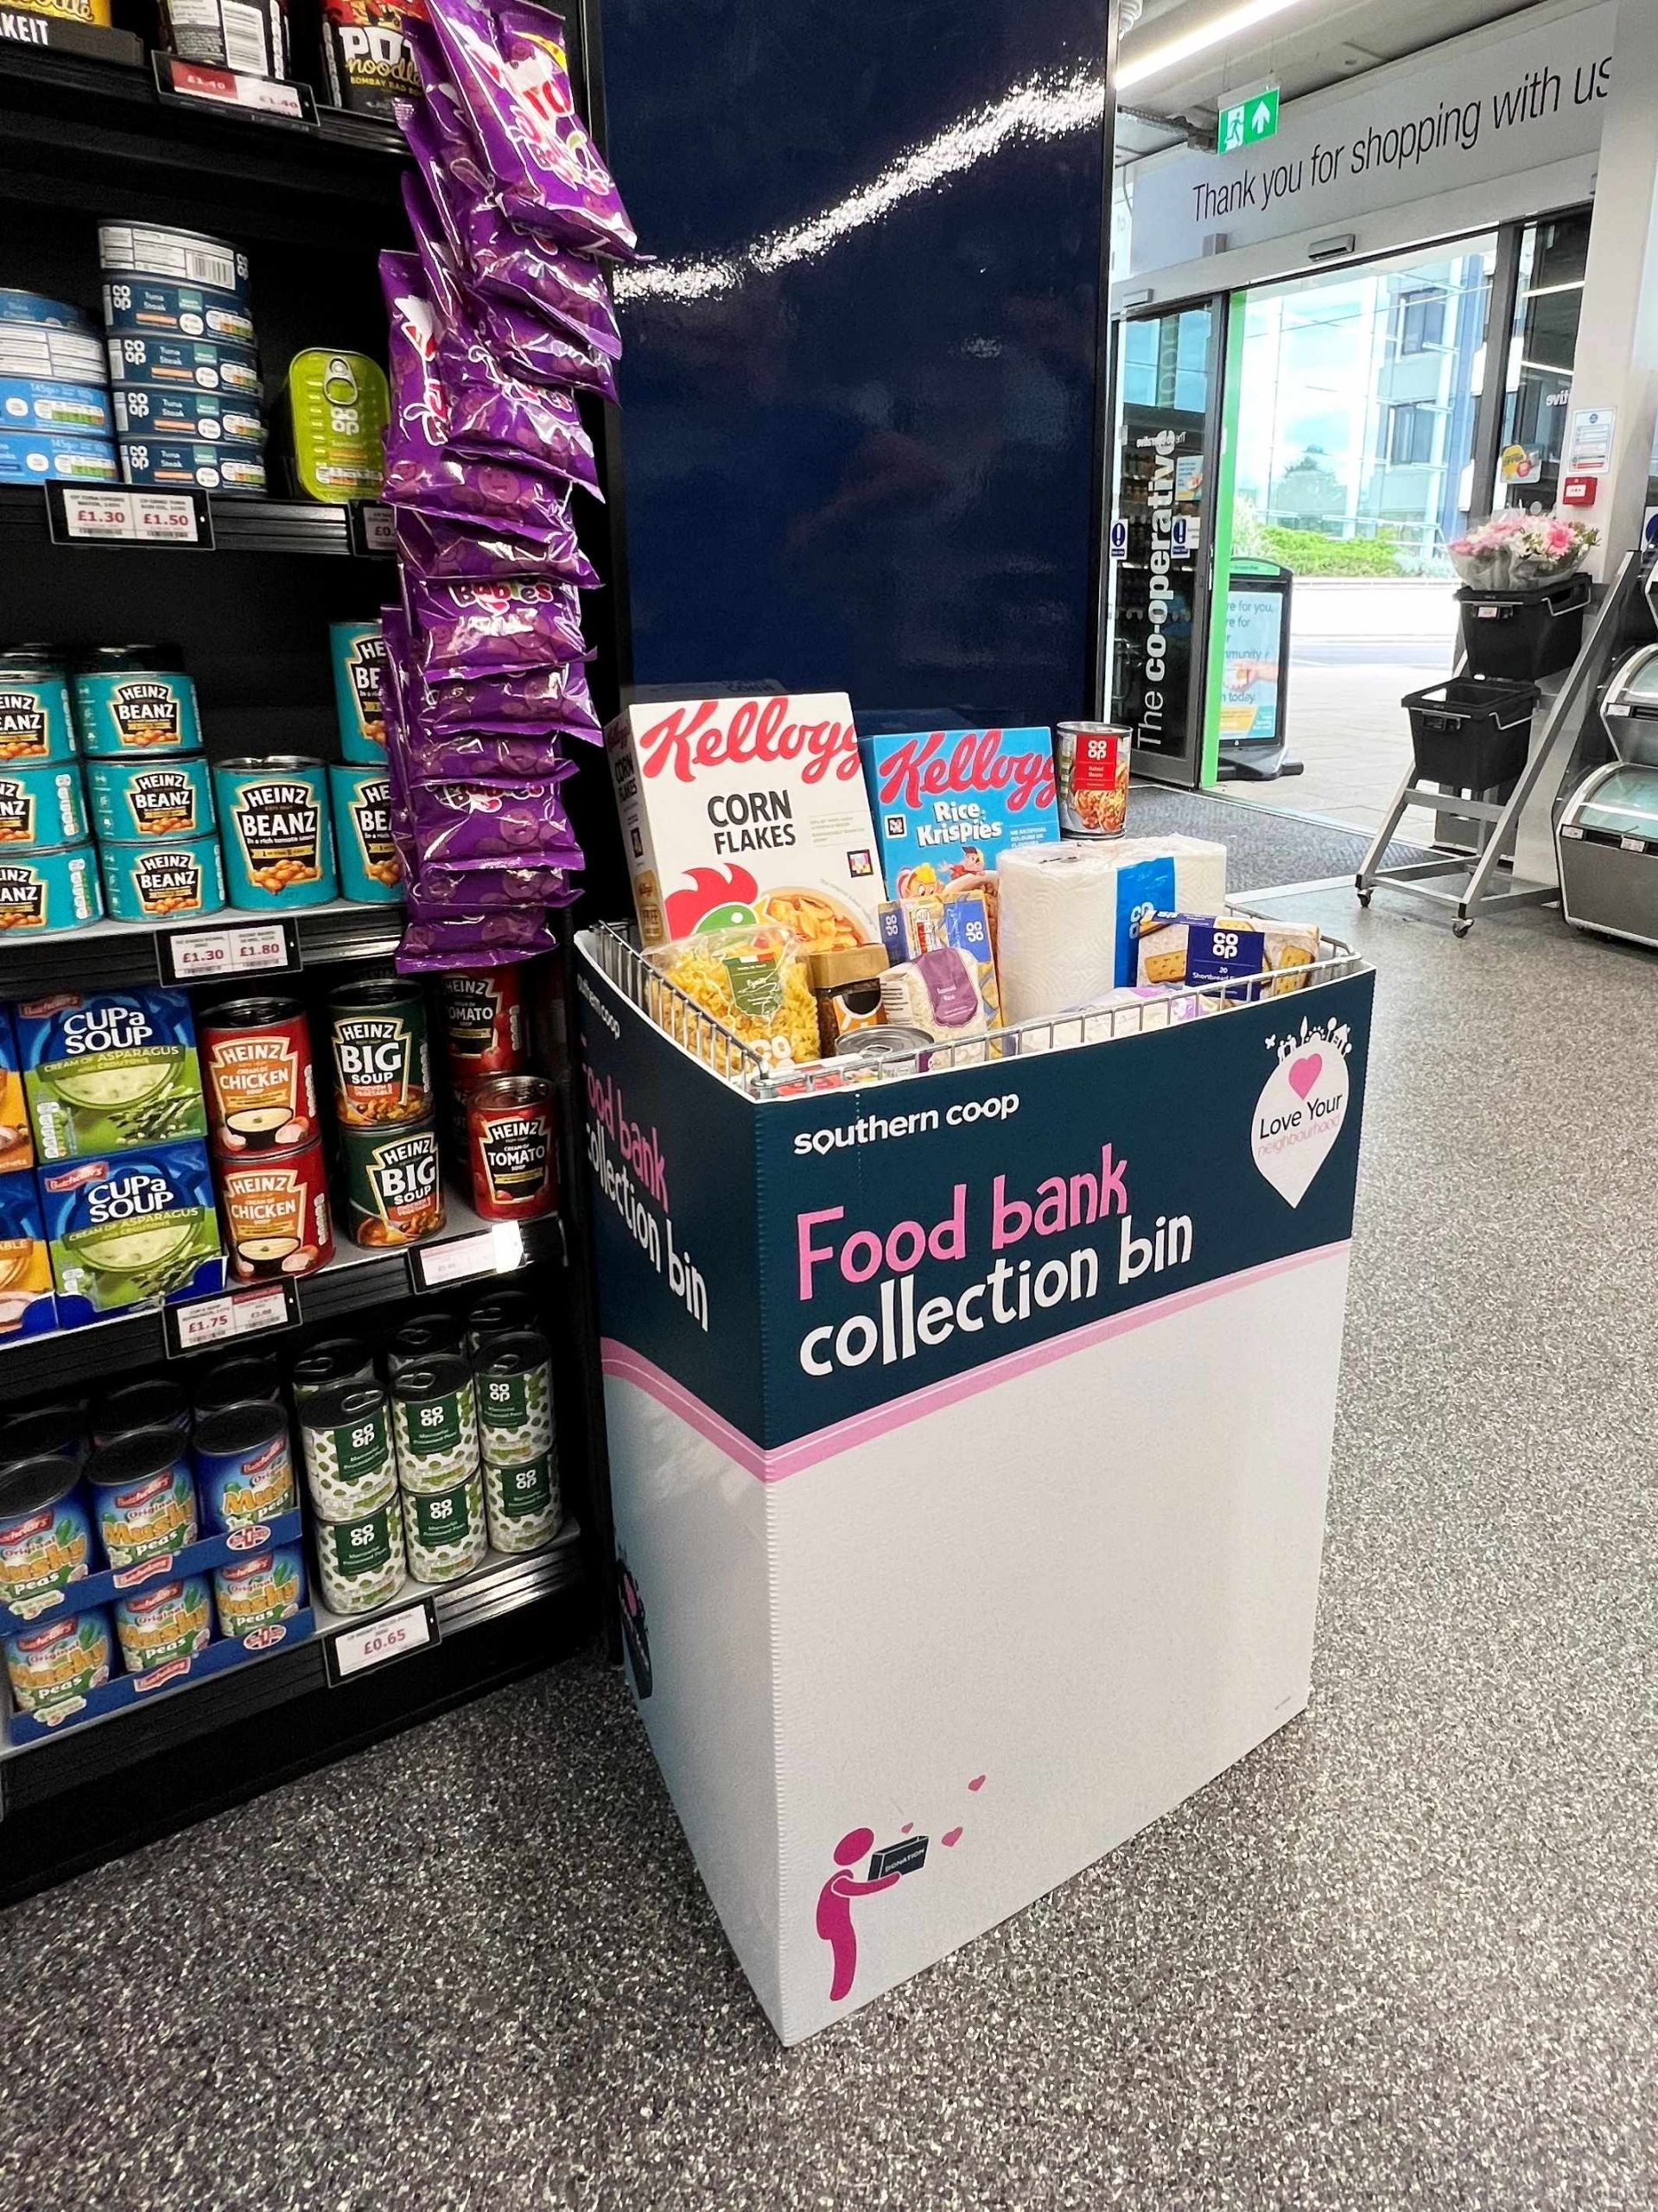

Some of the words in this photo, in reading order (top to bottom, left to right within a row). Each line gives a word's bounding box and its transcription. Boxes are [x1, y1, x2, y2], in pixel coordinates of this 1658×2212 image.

[350, 76, 386, 87] BOMBAY
[1193, 168, 1256, 222] Thank
[1263, 162, 1303, 210] you
[1312, 144, 1345, 187] for
[1350, 100, 1481, 169] shopping
[1493, 66, 1561, 129] with
[78, 510, 125, 524] £1.30
[143, 513, 189, 526] £1.50
[1146, 429, 1176, 683] co-operative
[1237, 617, 1250, 628] for
[121, 685, 167, 701] HEINZ
[118, 703, 175, 721] BEANZ
[1137, 691, 1163, 748] The
[138, 774, 184, 791] HEINZ
[135, 791, 190, 809] BEANZ
[247, 786, 307, 808] HEINZ
[708, 789, 793, 828] CORN
[242, 810, 316, 836] BEANZ
[933, 801, 981, 823] Rice
[714, 823, 796, 855] FLAKES
[917, 819, 1003, 848] Krispies
[143, 855, 189, 871] HEINZ
[140, 871, 196, 889] BEANZ
[182, 949, 224, 963] £1.30
[239, 944, 280, 957] £1.80
[65, 1027, 154, 1055] SOUP
[342, 1024, 394, 1041] HEINZ
[44, 1059, 79, 1073] CREAM
[81, 1057, 93, 1065] OF
[98, 1046, 179, 1062] ASPARAGUS
[223, 1044, 281, 1065] HEINZ
[340, 1042, 402, 1073] BIG
[219, 1068, 289, 1090] CHICKEN
[352, 1071, 394, 1084] SOUP
[1260, 1110, 1302, 1140] Love
[1306, 1094, 1343, 1121] Your
[492, 1122, 537, 1141] HEINZ
[794, 1109, 938, 1155] southern
[1258, 1115, 1342, 1158] neighbourhood
[384, 1140, 430, 1165] HEINZ
[487, 1145, 545, 1166] TOMATO
[616, 1089, 670, 1214] bank
[232, 1177, 288, 1194] HEINZ
[380, 1156, 435, 1197] BIG
[393, 1185, 432, 1205] SOUP
[90, 1191, 175, 1224] SOUP
[231, 1198, 296, 1219] CHICKEN
[69, 1227, 104, 1242] CREAM
[105, 1224, 118, 1233] OF
[121, 1207, 200, 1228] ASPARAGUS
[797, 1184, 967, 1301] Food
[992, 1142, 1128, 1249] bank
[666, 1219, 708, 1332] bin
[799, 1247, 1099, 1376] collection
[1118, 1214, 1193, 1284] bin
[188, 1314, 228, 1333] £1.75
[103, 1497, 194, 1545] Mushy
[3, 1536, 55, 1557] Original
[136, 1531, 178, 1555] peas
[15, 1572, 60, 1595] peas
[230, 1578, 273, 1594] Original
[137, 1603, 185, 1625] Original
[237, 1609, 274, 1626] peas
[118, 1603, 209, 1649] Mushy
[29, 1640, 79, 1664] Original
[145, 1637, 187, 1658] peas
[364, 1628, 406, 1655] £0.65
[10, 1638, 107, 1687] Mushy
[38, 1675, 83, 1700] peas
[885, 1848, 925, 1872] DONATION
